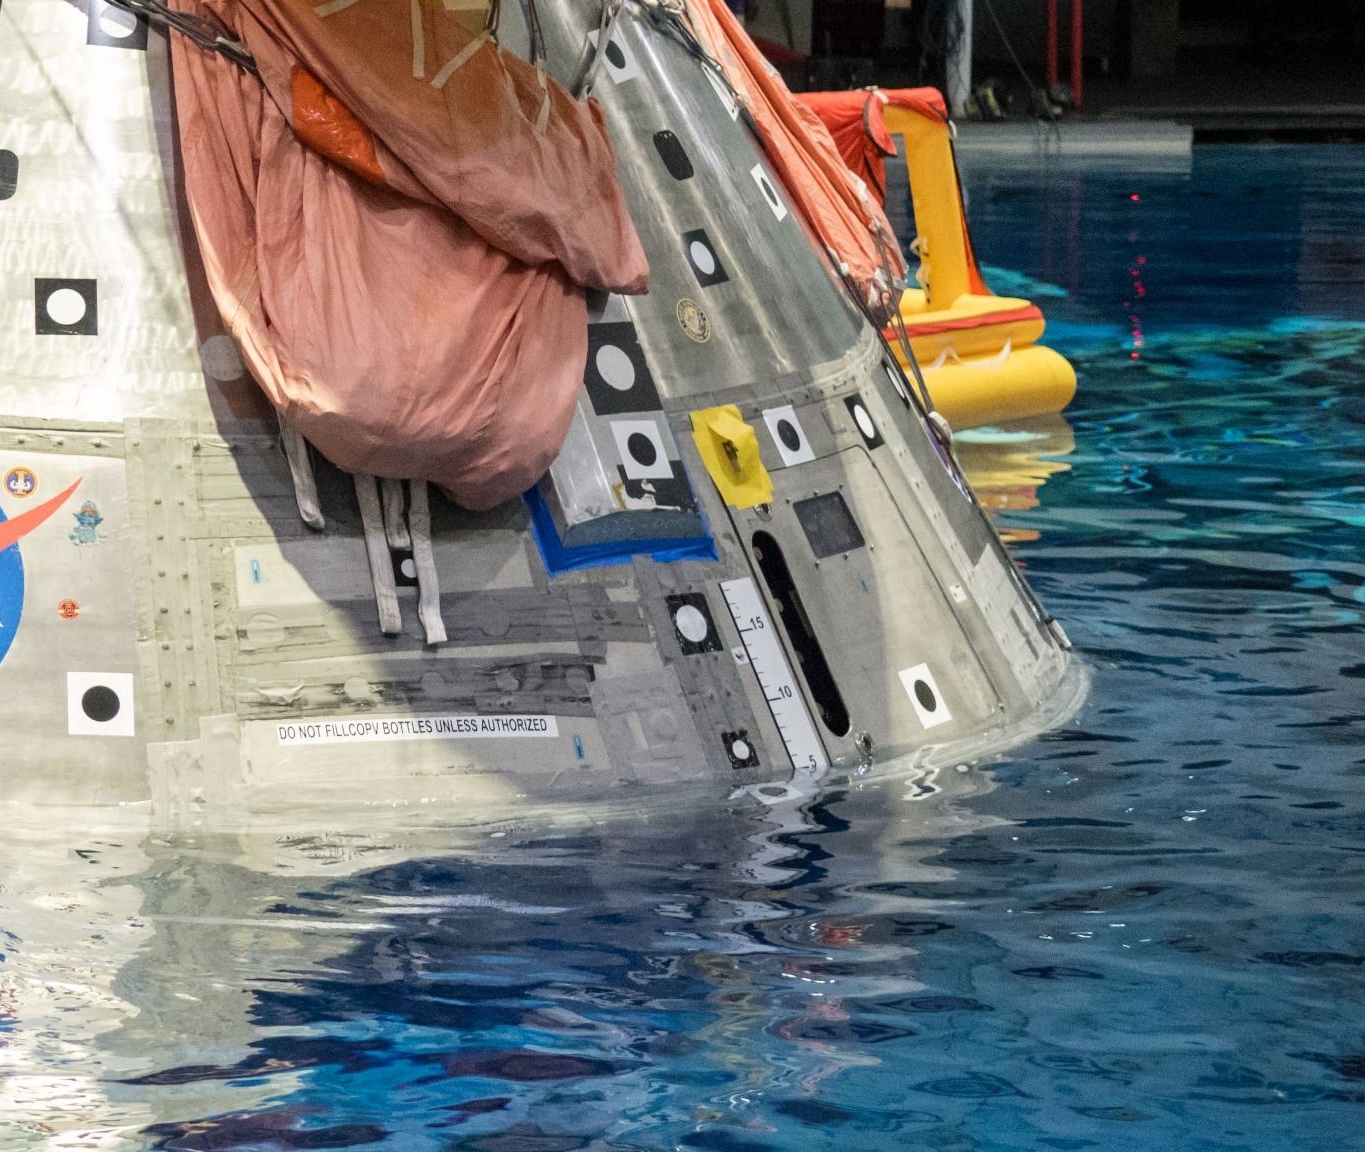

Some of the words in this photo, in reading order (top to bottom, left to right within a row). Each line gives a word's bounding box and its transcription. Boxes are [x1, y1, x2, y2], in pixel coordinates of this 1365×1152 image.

[749, 615, 765, 630] 15
[777, 684, 793, 700] 10
[278, 725, 296, 741] DO
[299, 724, 322, 739] NOT
[325, 722, 380, 738] FILLCOPV
[383, 720, 433, 735] BOTTLES
[435, 718, 478, 733] UNLESS
[481, 718, 548, 733] AUTHORIZED
